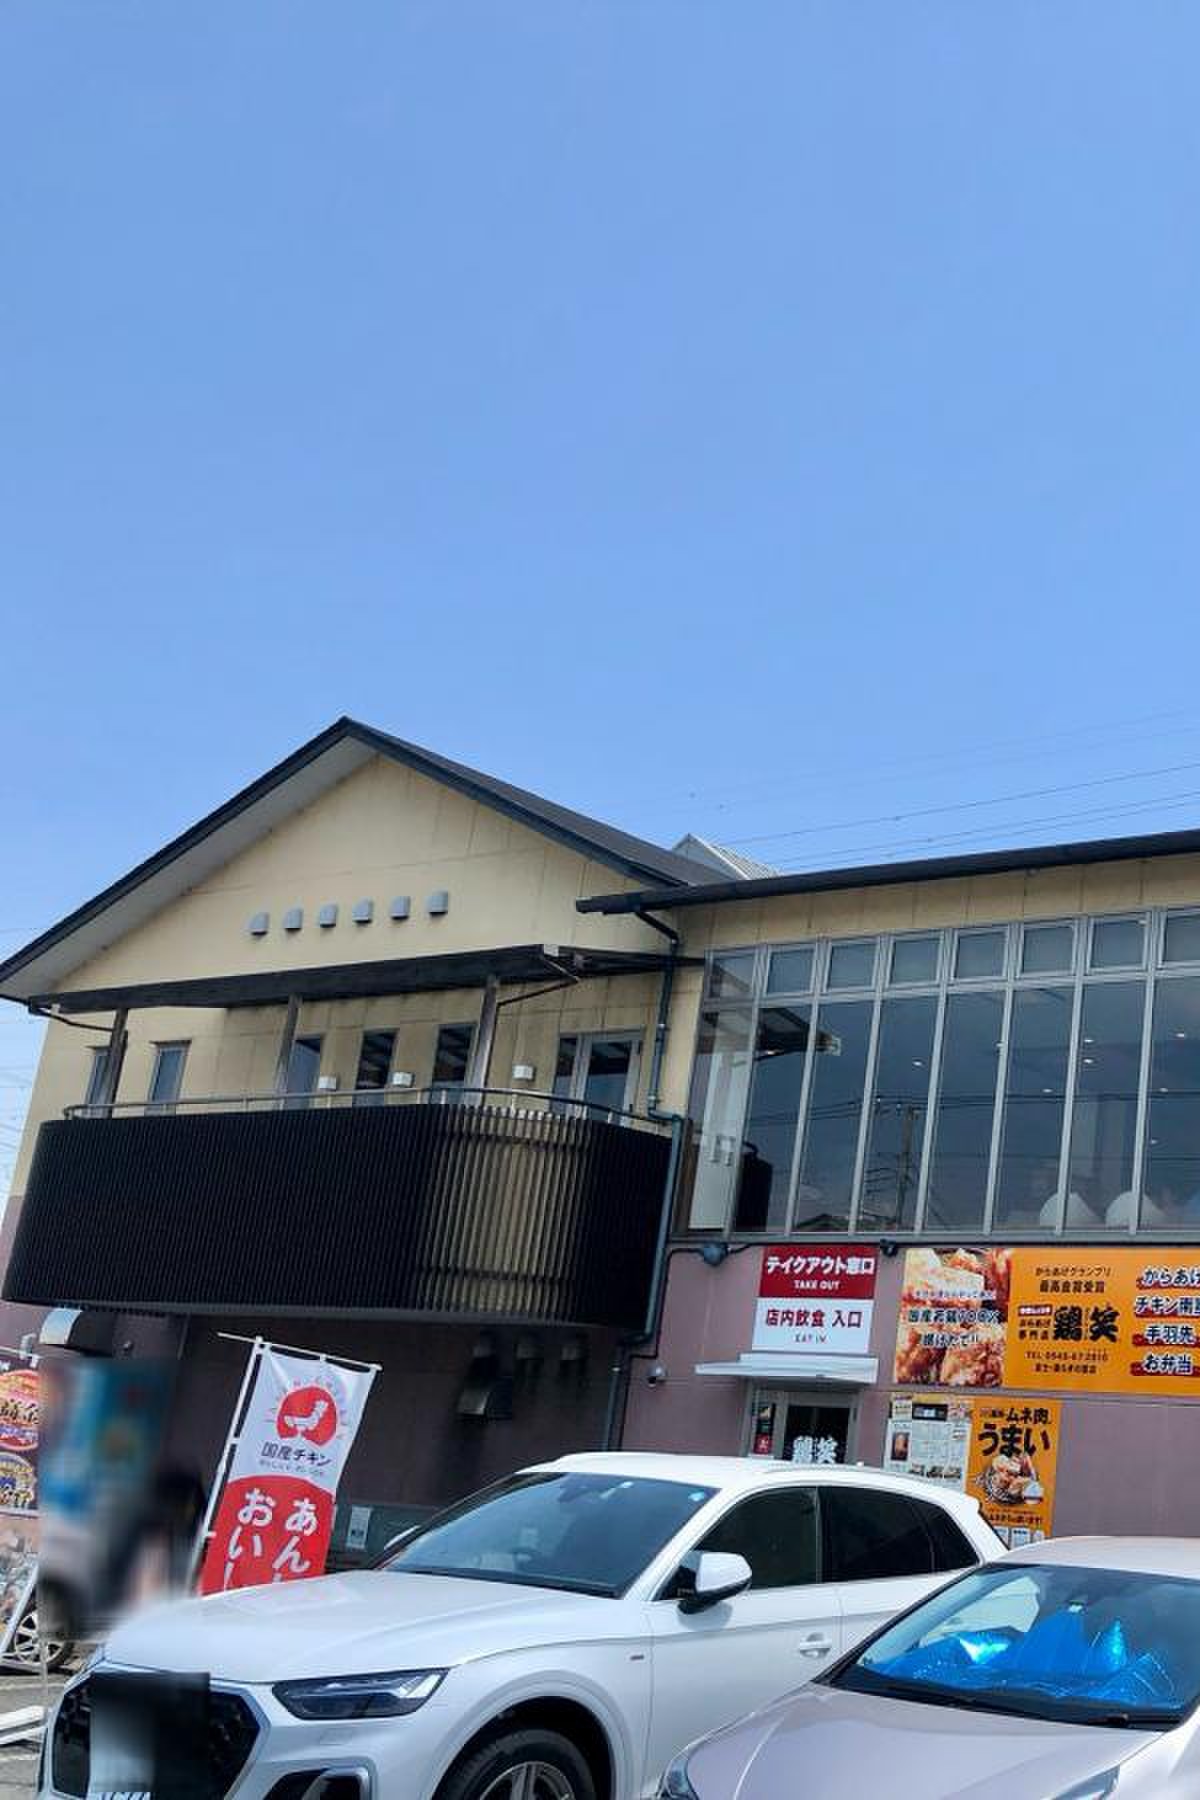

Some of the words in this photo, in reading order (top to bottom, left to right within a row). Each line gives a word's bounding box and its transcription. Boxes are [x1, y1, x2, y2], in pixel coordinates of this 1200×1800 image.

[766, 1256, 875, 1275] テイクアウト窓口
[1035, 1265, 1112, 1277] からあげグランプリ
[794, 1280, 817, 1290] TAKE
[820, 1280, 840, 1290] OUT
[766, 1308, 826, 1328] 店内飲食
[832, 1310, 862, 1328] 入口
[1145, 1325, 1194, 1344] 手羽先
[1144, 1353, 1193, 1374] お弁当
[978, 1423, 1051, 1457] うまい
[261, 1441, 332, 1467] 国産チキン
[272, 1497, 319, 1584] あん
